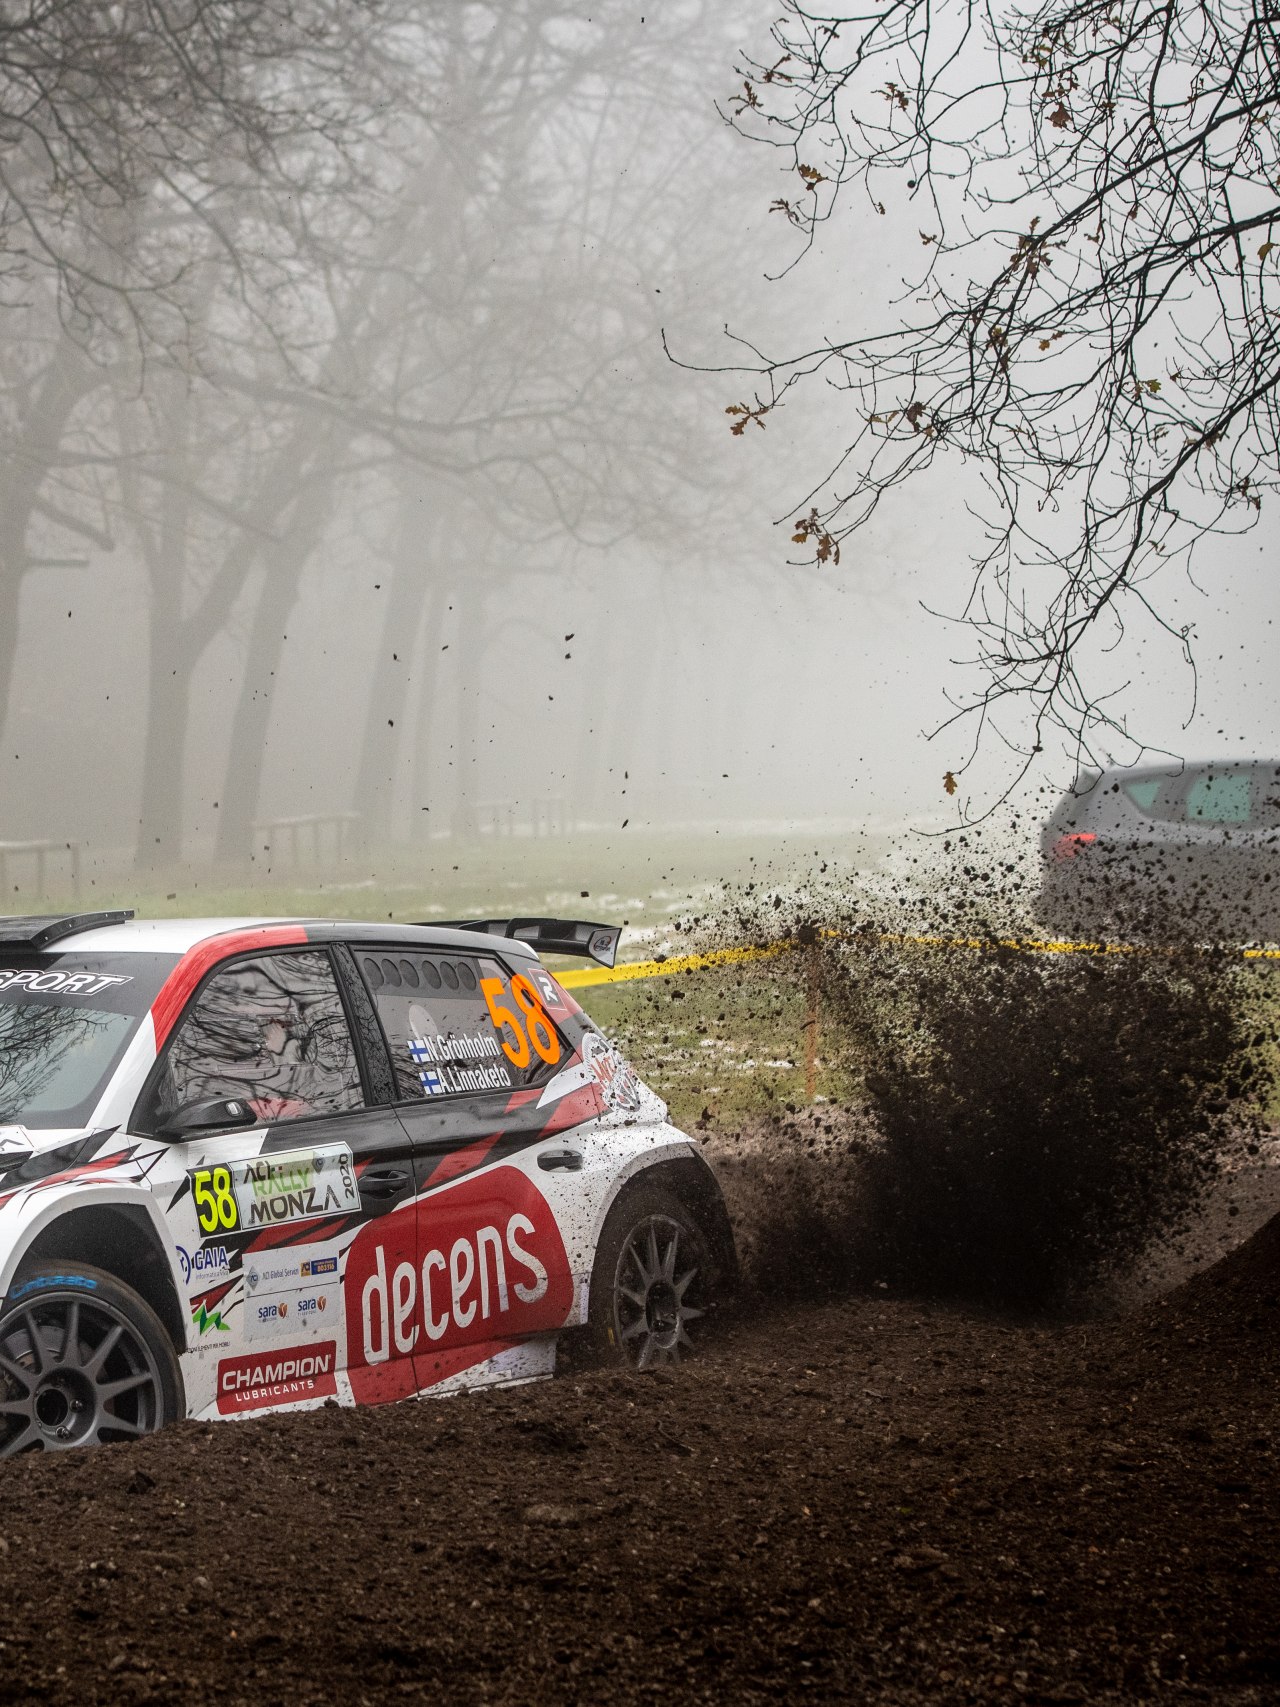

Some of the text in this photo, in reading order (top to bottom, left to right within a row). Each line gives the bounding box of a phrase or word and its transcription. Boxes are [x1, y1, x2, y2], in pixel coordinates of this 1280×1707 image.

[480, 974, 561, 1069] 58
[423, 1032, 500, 1061] N.Grönholm
[436, 1064, 511, 1093] A.Linnaketo
[252, 1167, 310, 1197] RALLY
[339, 1153, 355, 1199] 2020
[194, 1168, 237, 1232] 58
[249, 1184, 341, 1225] MONZA
[195, 1247, 228, 1270] GAIA
[361, 1213, 548, 1366] decens
[258, 1305, 277, 1319] sara
[297, 1298, 316, 1312] sara
[222, 1354, 329, 1391] CHAMPION
[236, 1380, 314, 1402] LUBRICANTS
